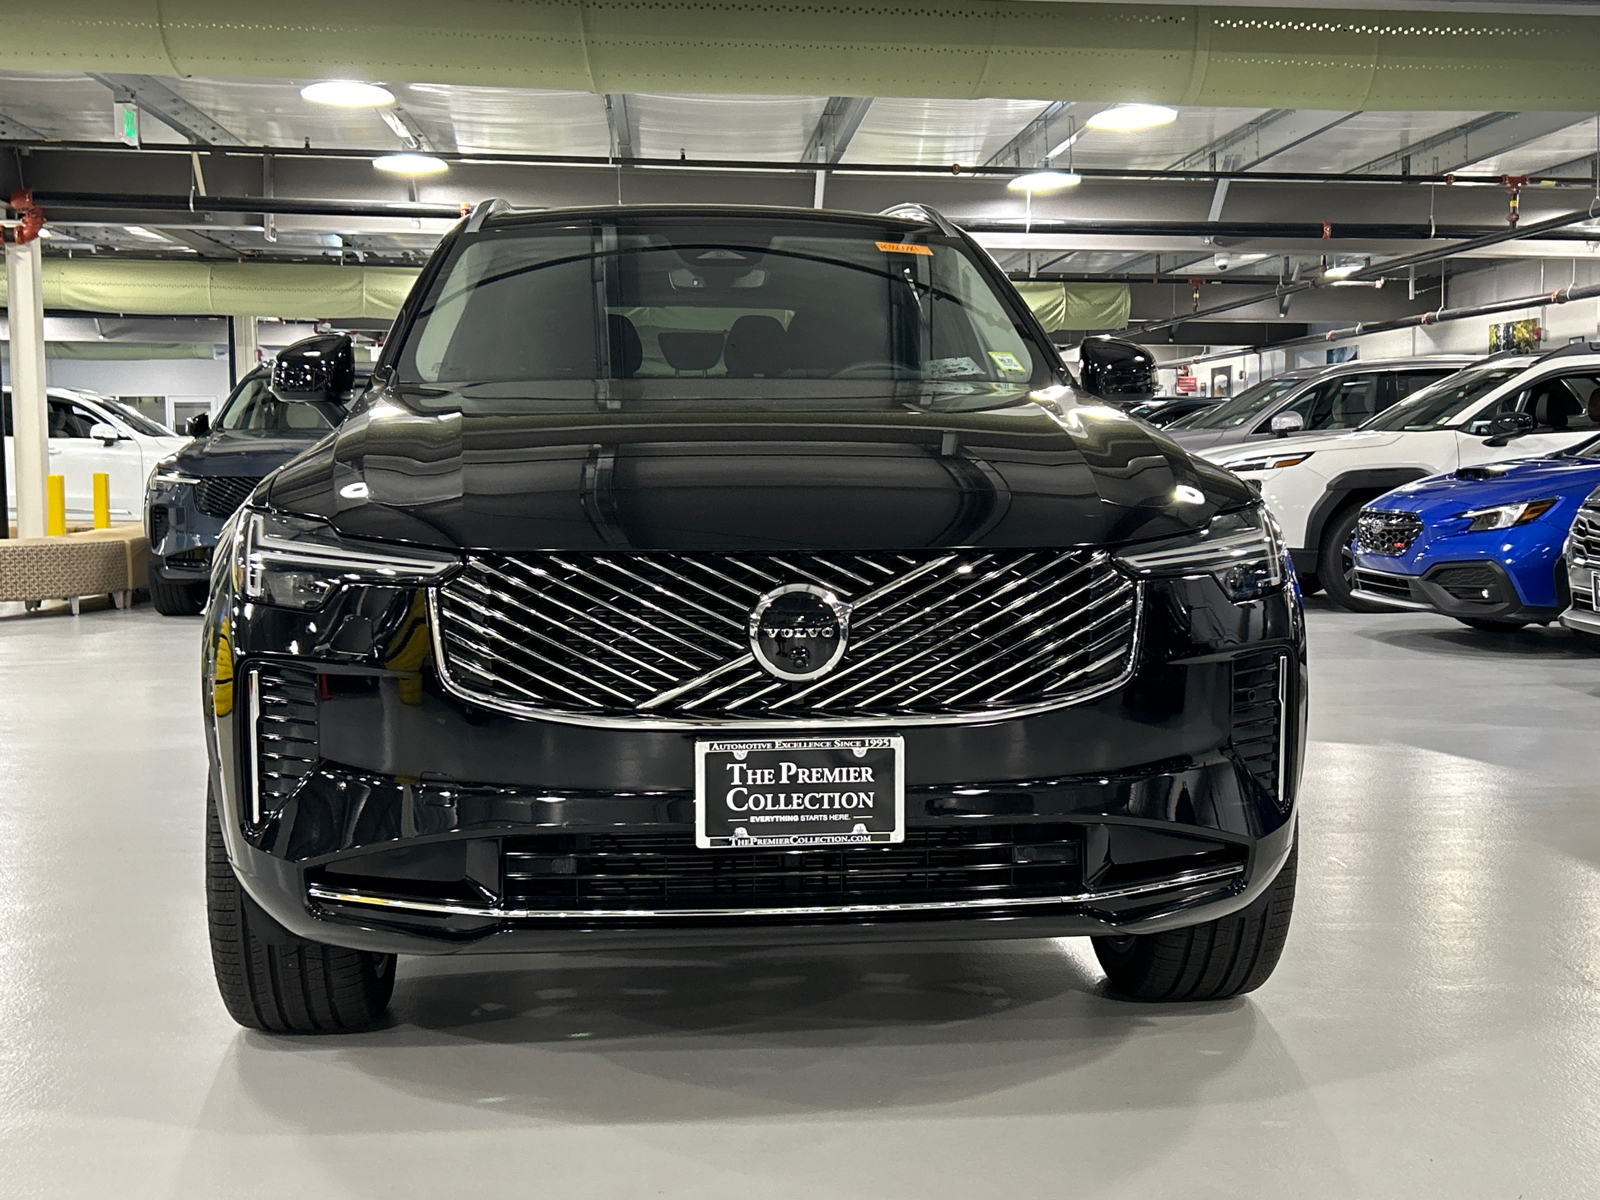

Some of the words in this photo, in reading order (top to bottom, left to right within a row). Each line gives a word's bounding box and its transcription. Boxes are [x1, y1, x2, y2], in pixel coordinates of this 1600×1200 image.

[763, 627, 834, 638] VOLVO
[711, 742, 773, 751] AUTOMOTIVE
[775, 741, 832, 749] EXCELLENCE
[833, 739, 862, 748] SINCE
[864, 738, 890, 748] 1995
[726, 762, 775, 786] THE
[778, 762, 875, 784] PREMIER
[726, 787, 875, 811] COLLECTION
[829, 813, 851, 821] HERE.
